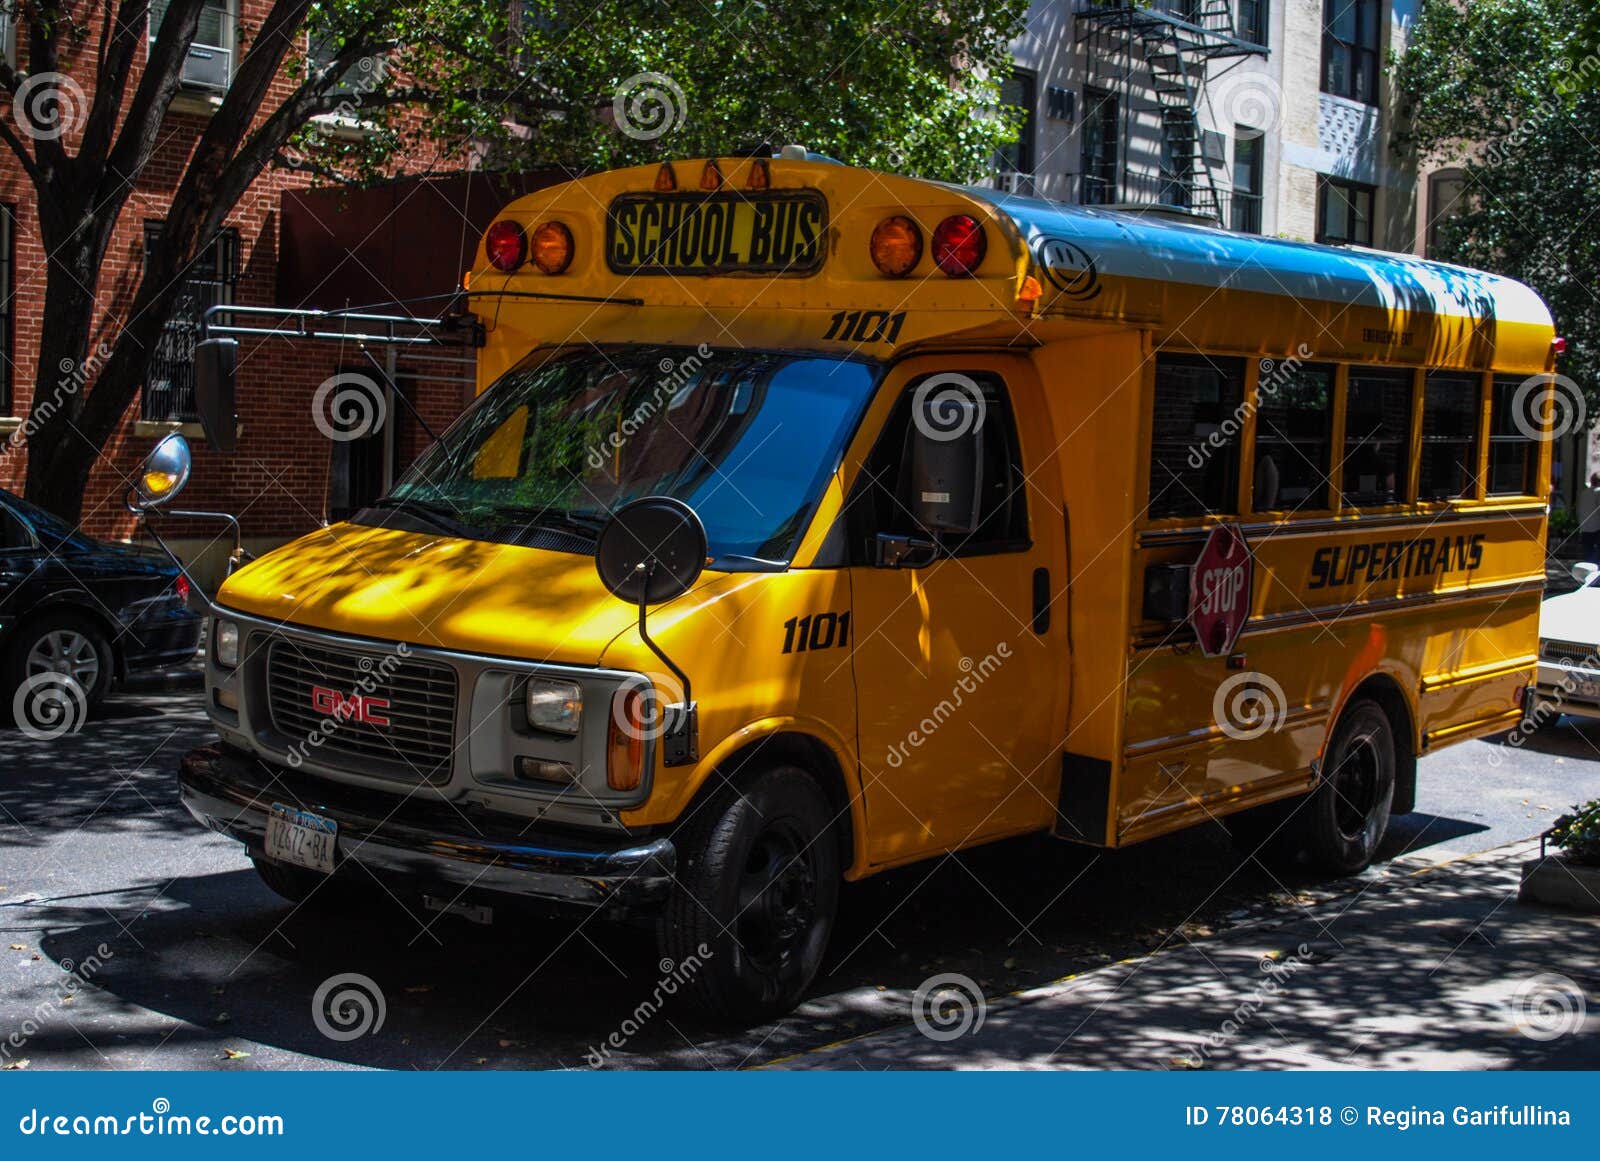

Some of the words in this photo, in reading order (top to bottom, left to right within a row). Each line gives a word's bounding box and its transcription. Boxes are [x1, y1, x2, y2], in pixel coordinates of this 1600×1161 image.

[616, 202, 739, 265] SCHOOL
[750, 201, 819, 264] BUS
[822, 310, 907, 344] 1101
[1308, 534, 1486, 589] SUPERTRANS
[1201, 566, 1244, 615] STOP
[782, 610, 850, 654] 1101
[312, 686, 390, 727] GMC
